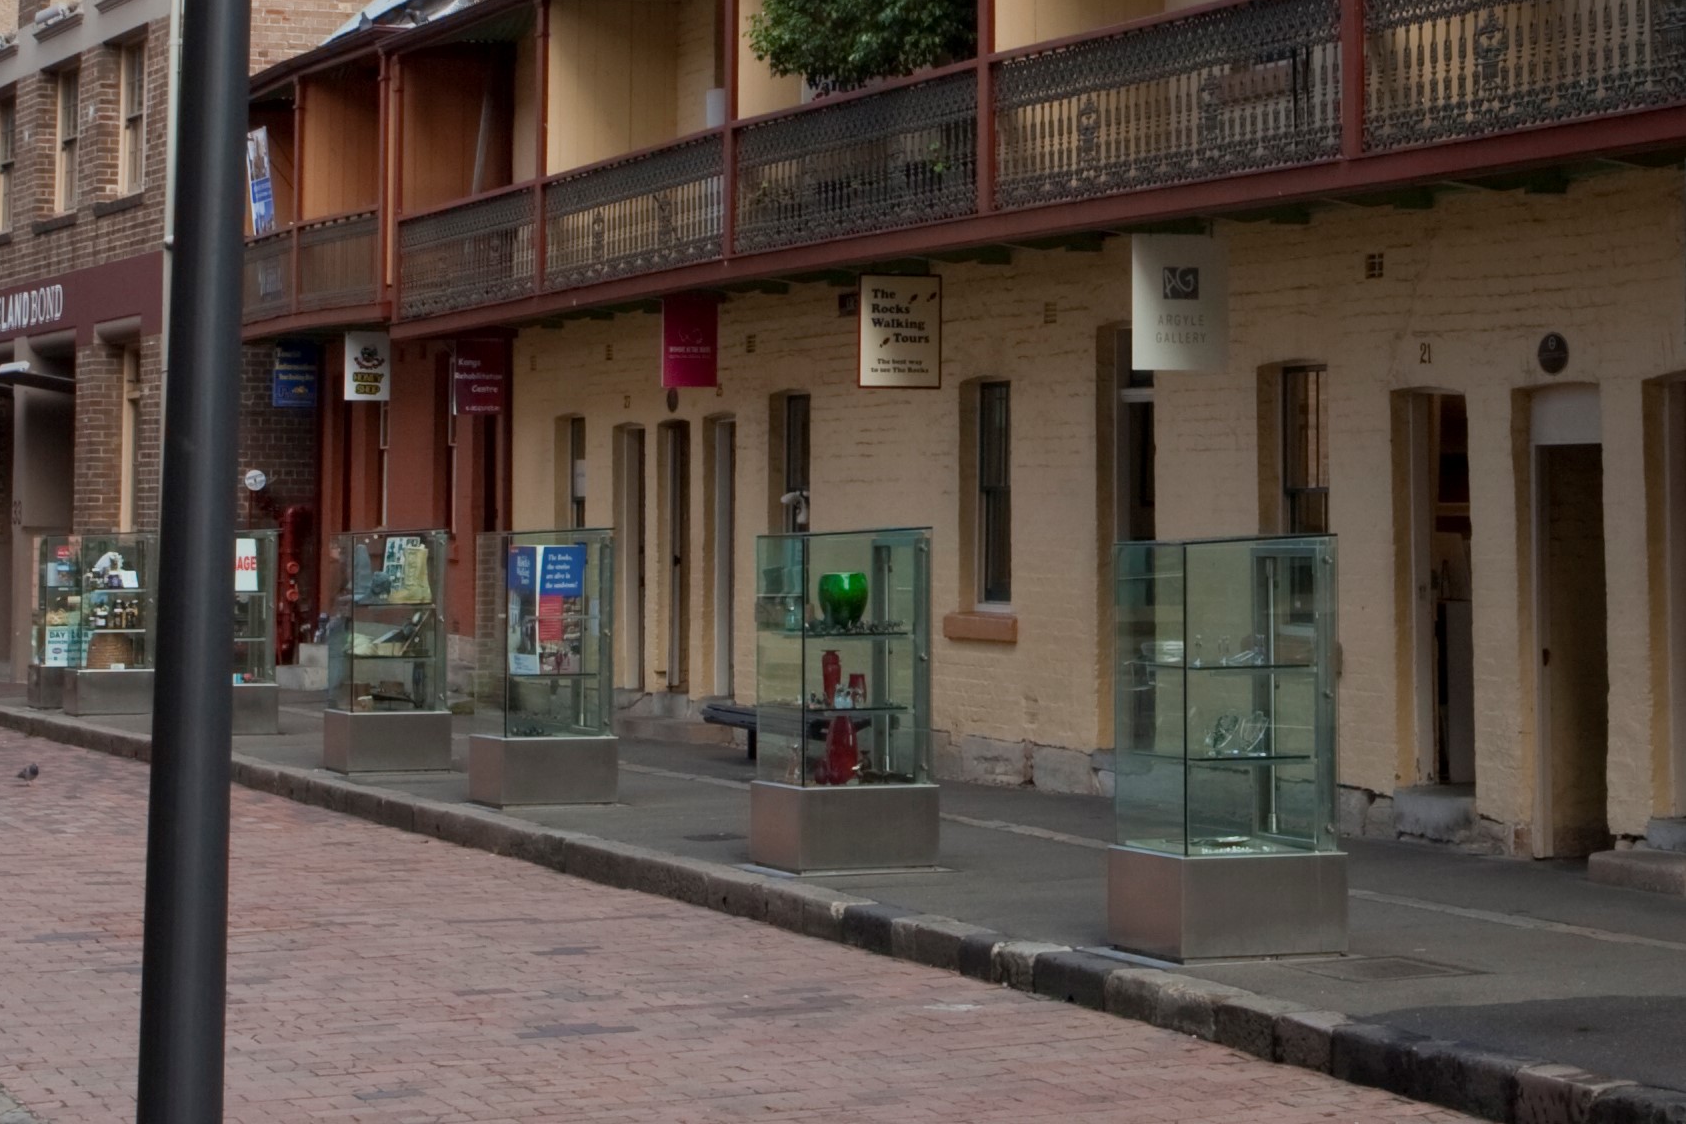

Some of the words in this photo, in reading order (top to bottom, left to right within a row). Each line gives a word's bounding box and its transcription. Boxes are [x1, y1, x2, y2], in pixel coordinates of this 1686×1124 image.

[1164, 267, 1195, 299] AG
[871, 288, 896, 299] The
[30, 284, 64, 325] BOND
[871, 303, 911, 314] Rocks
[871, 318, 926, 331] Walking
[1158, 314, 1205, 326] ARGYLE
[893, 332, 930, 344] Tours
[1155, 332, 1207, 344] GALLERY
[1419, 342, 1432, 365] 21
[908, 359, 923, 367] way
[234, 555, 257, 571] AGE
